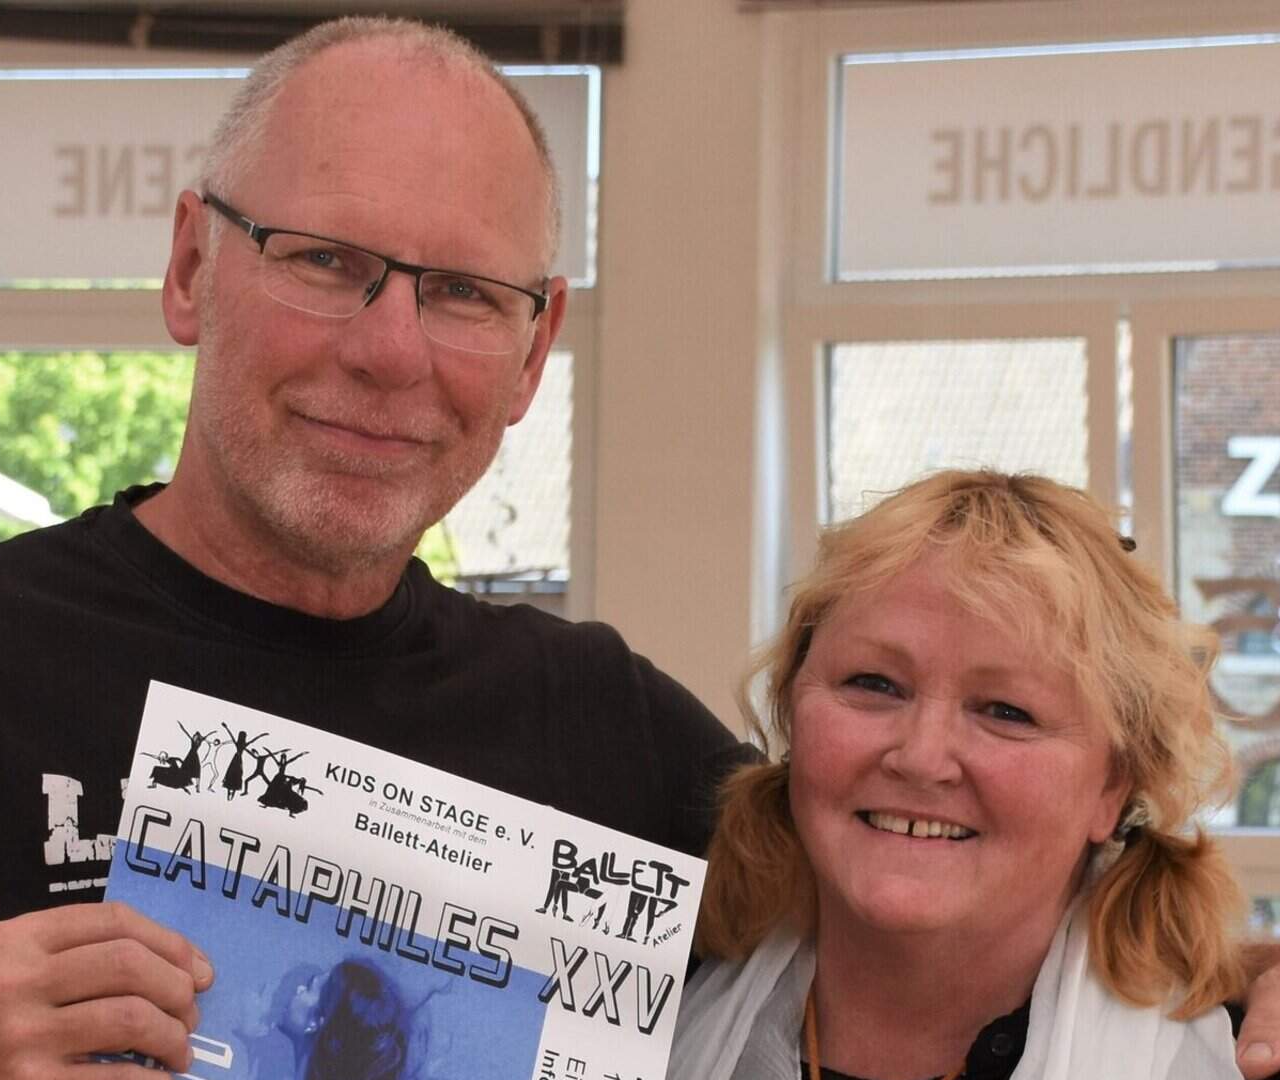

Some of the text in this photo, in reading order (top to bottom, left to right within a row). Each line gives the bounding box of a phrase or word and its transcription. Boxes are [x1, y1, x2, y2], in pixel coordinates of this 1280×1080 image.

[325, 762, 536, 849] KIDS ON STAGE e. V.
[379, 802, 452, 834] Zusammenarbeit
[452, 828, 467, 839] mit
[468, 833, 488, 846] dem
[354, 812, 493, 873] Ballett-Atelier
[552, 838, 690, 900] BALLETT
[123, 804, 519, 989] CATAPHILES
[537, 937, 675, 1036] XXV
[653, 922, 683, 948] Atelier
